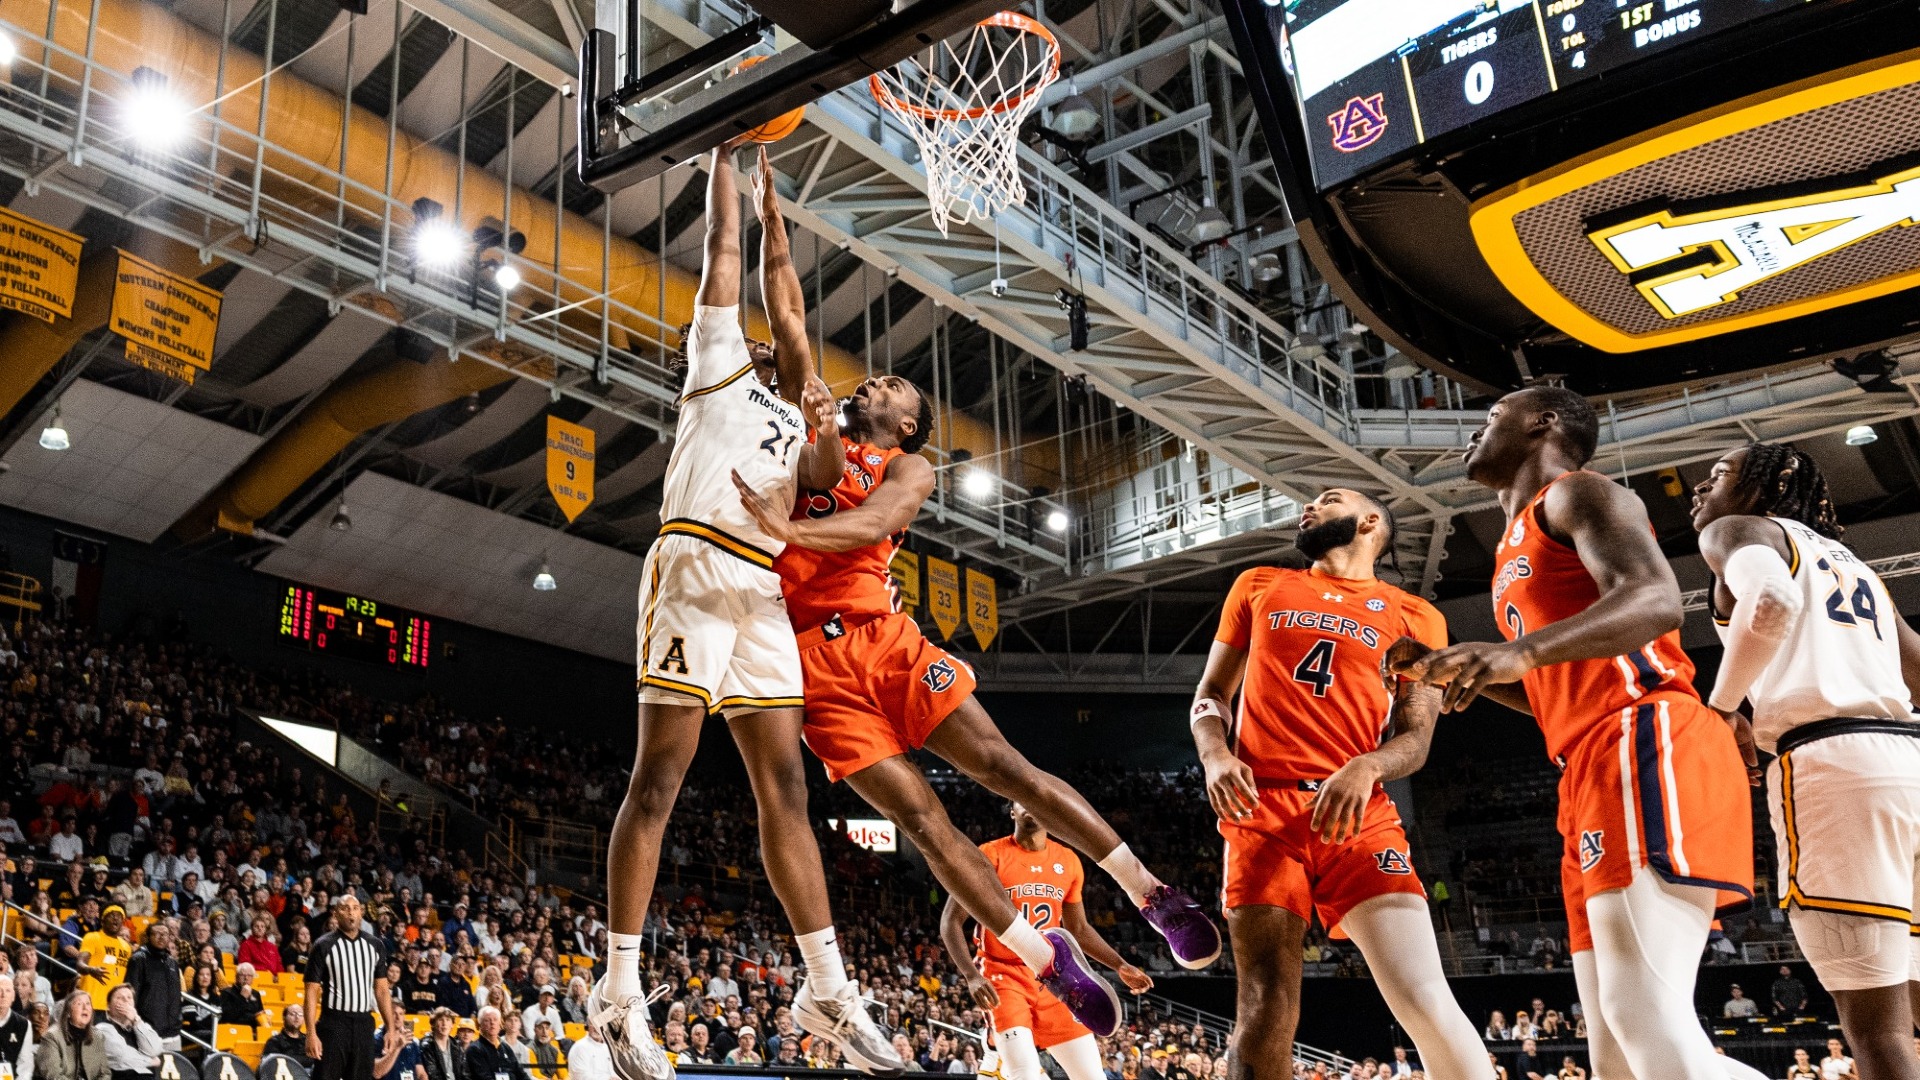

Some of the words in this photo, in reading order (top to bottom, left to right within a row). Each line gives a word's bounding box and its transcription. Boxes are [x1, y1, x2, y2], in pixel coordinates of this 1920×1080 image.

[1562, 13, 1576, 33] 0
[1620, 2, 1654, 30] 1ST
[1634, 9, 1702, 48] BONUS
[1440, 26, 1498, 65] TIGERS
[1561, 31, 1586, 51] TOL
[1571, 50, 1586, 69] 4
[1464, 60, 1495, 105] 0
[0, 244, 49, 269] HAMPIONS
[119, 273, 165, 291] SOUTHERN
[166, 284, 217, 322] CONFERENCE
[759, 420, 797, 466] 21
[566, 460, 575, 480] 9
[346, 596, 376, 617] 19:23
[937, 590, 952, 609] 33
[975, 601, 990, 620] 22
[1815, 556, 1884, 641] 24
[1268, 610, 1380, 649] TIGERS
[659, 635, 690, 676] A
[1293, 639, 1336, 698] 4
[848, 827, 891, 846] gles
[1004, 882, 1065, 903] TIGERS
[1021, 902, 1053, 931] 12
[118, 949, 129, 959] AR
[160, 1053, 181, 1080] A
